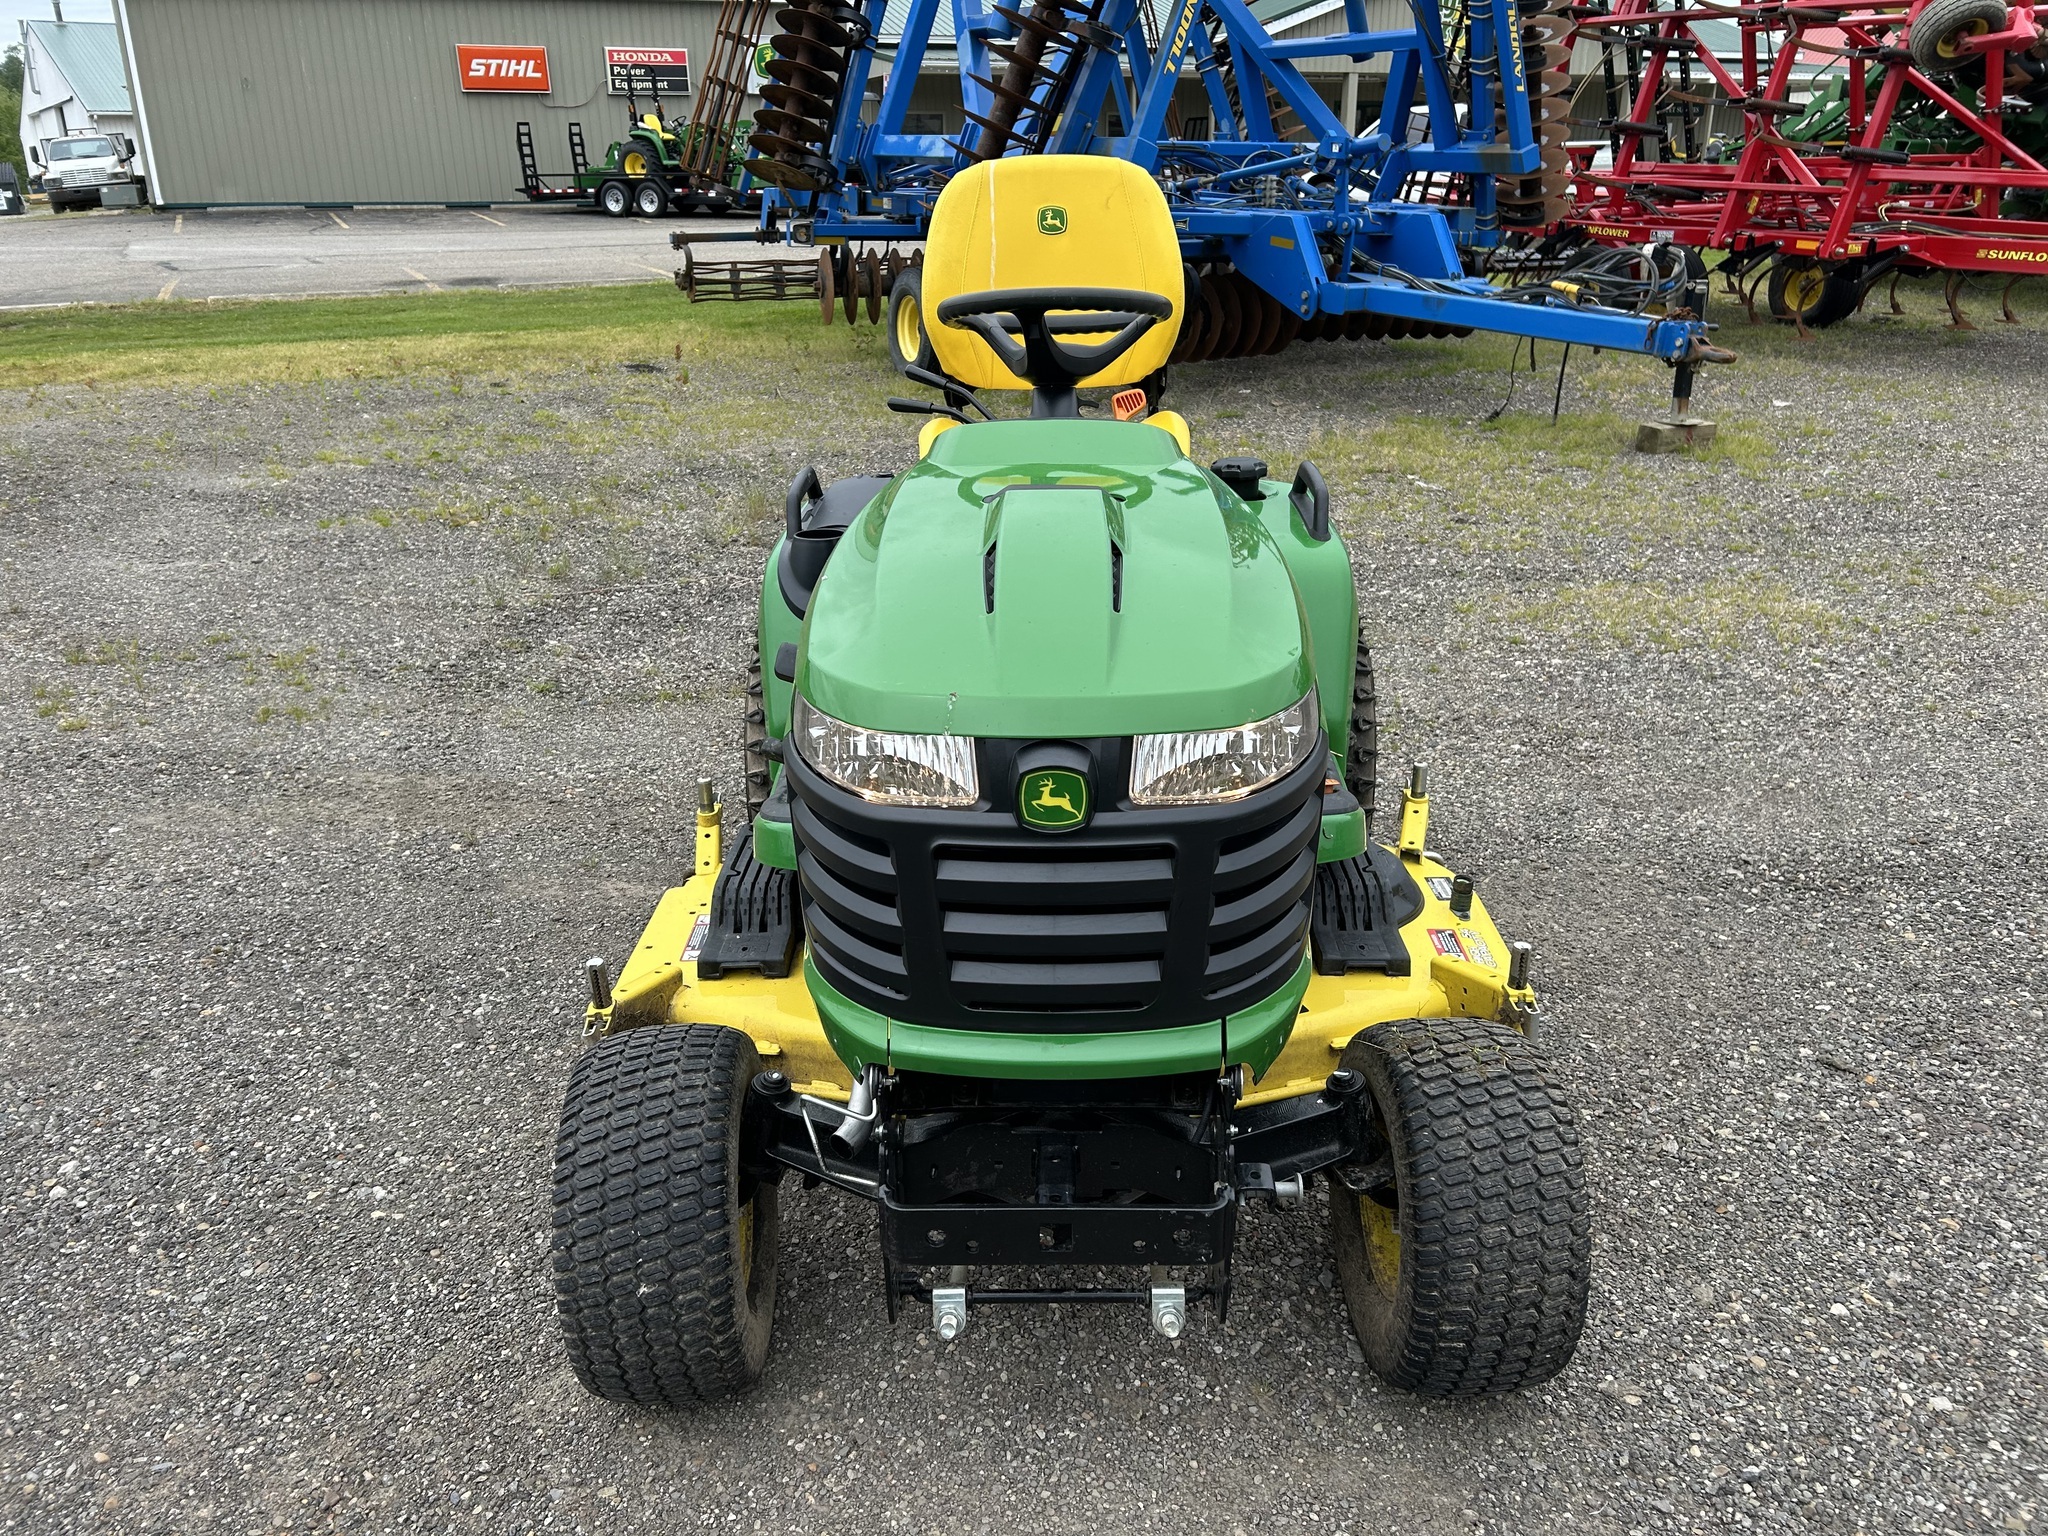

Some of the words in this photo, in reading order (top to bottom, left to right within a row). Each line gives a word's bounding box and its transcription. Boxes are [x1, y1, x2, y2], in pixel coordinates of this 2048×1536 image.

[1507, 0, 1525, 92] LANDOL
[612, 52, 675, 62] HONDA
[468, 58, 542, 78] STIHL
[615, 80, 668, 90] Eqipmnt
[1987, 249, 2048, 262] SUNFLO
